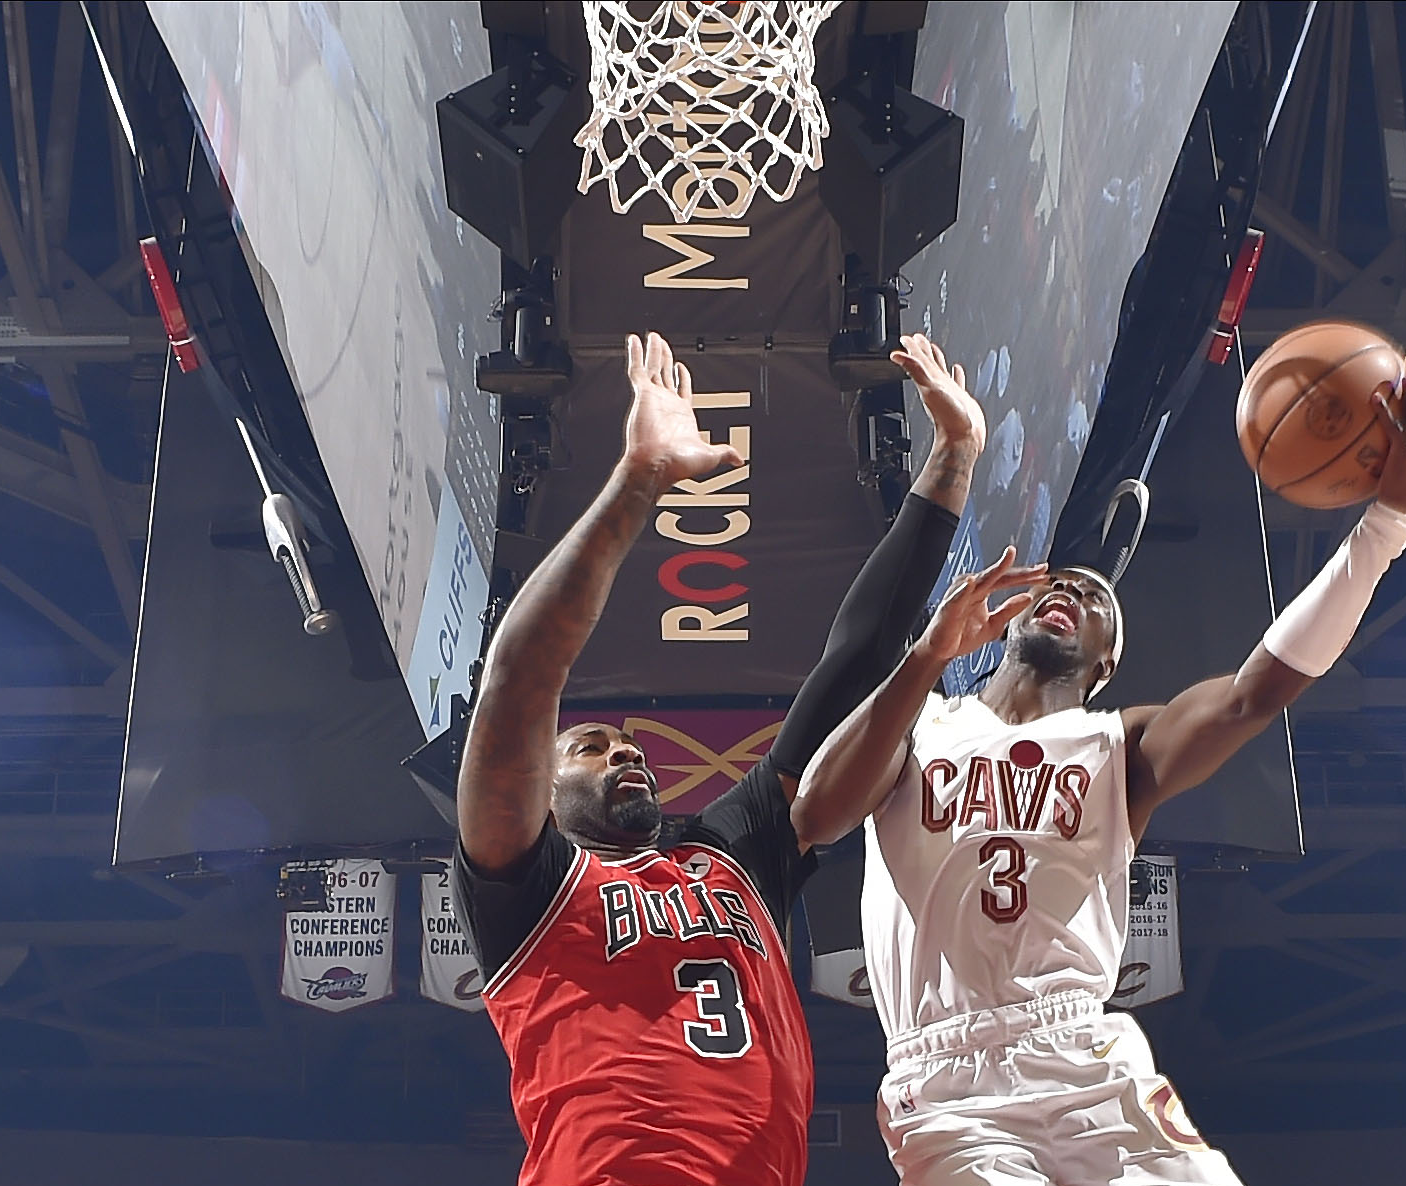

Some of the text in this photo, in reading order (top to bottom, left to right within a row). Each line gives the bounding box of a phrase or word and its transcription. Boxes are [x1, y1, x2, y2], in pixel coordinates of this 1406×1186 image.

[439, 522, 472, 671] CLIFFS
[922, 742, 1091, 841] CAVS
[327, 897, 376, 913] STERN
[599, 880, 767, 962] BULLS
[979, 836, 1028, 924] 3
[291, 917, 389, 935] CONFERENCE
[294, 939, 384, 957] CHAMPIONS
[673, 958, 752, 1058] 3
